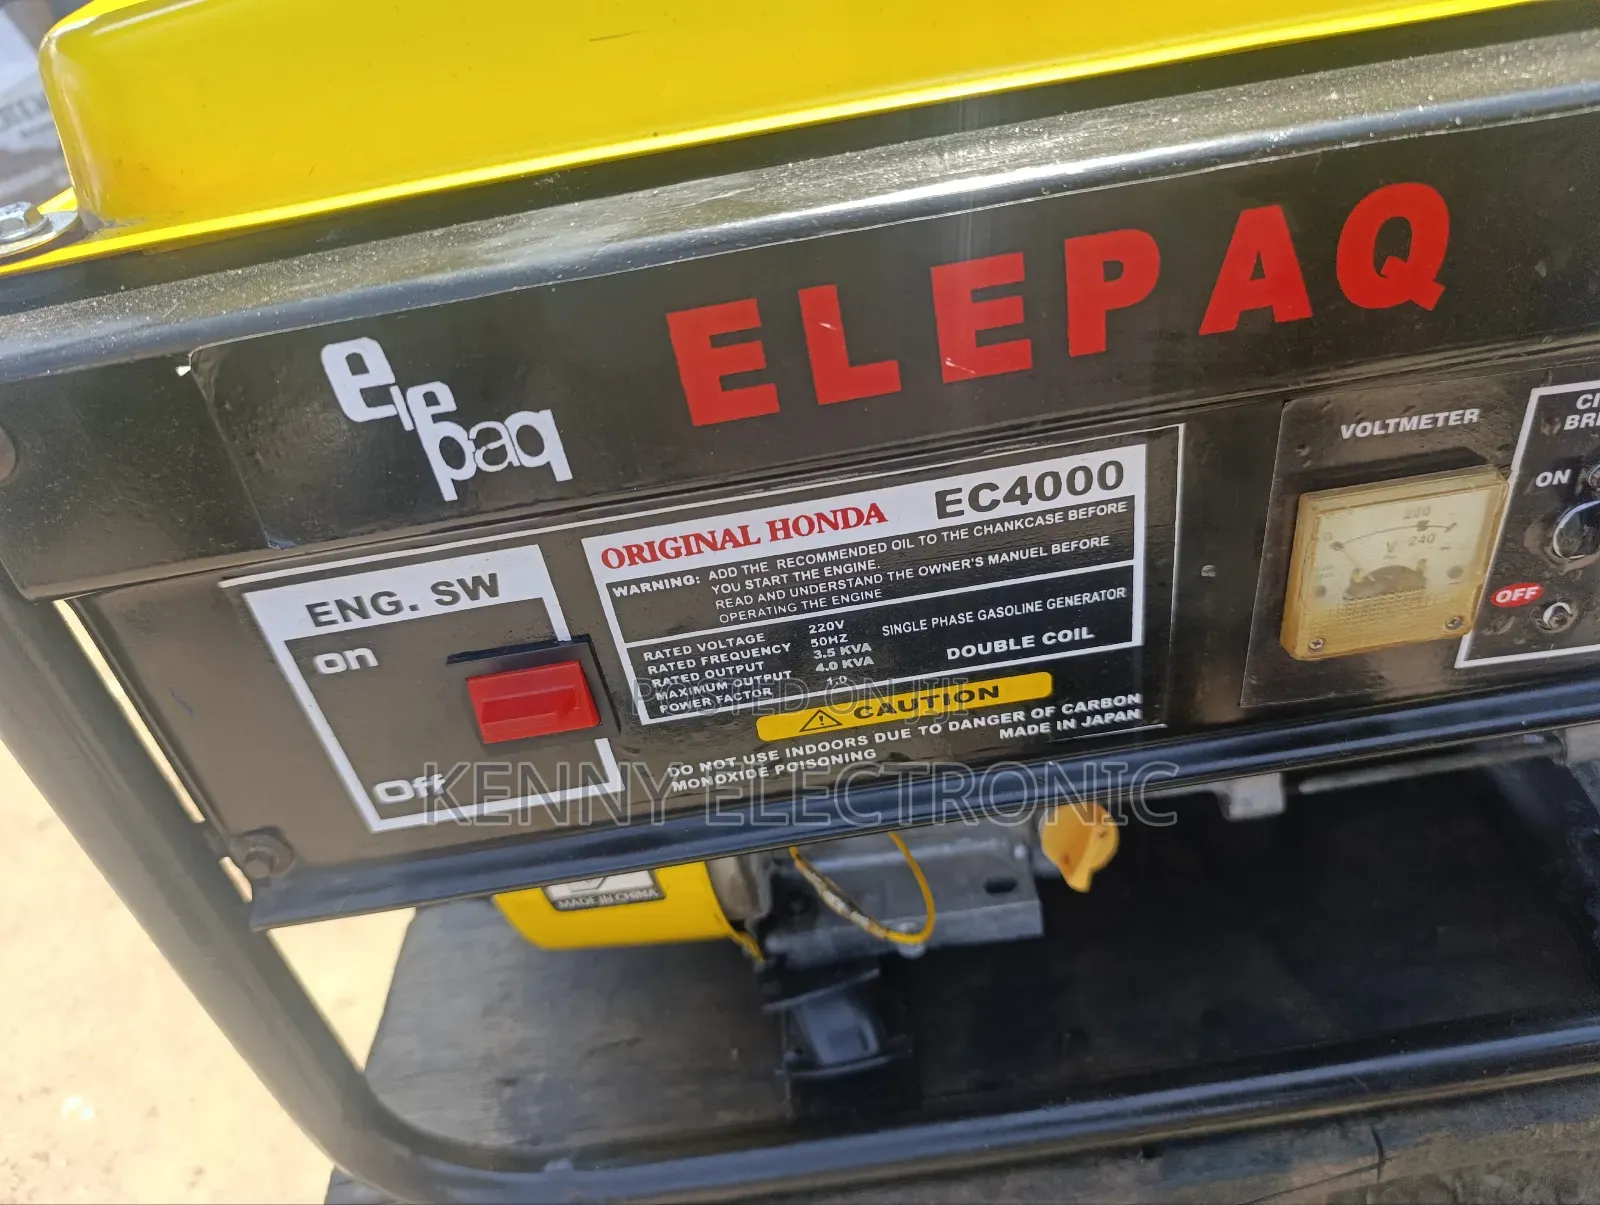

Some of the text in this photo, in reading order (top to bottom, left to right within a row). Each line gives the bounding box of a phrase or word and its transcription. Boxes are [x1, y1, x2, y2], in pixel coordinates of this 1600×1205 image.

[665, 181, 1450, 427] ELEPAQ
[1340, 408, 1480, 440] VOLTMETER
[935, 460, 1124, 519] EC4000
[1535, 469, 1572, 487] ON
[601, 503, 888, 569] ORIGINAL HONDA
[612, 501, 1128, 597] WARNING: ADD THE RECOMMENDED OIL TO THE CHANKCASE BEFORE
[711, 559, 881, 595] YOU START THE ENGINE.
[715, 536, 1110, 609] READ AND UNDERSTAND THE OWNER'S MANUEL BEFORE
[305, 572, 499, 627] ENG. SW
[719, 589, 882, 624] OPERATING THE ENGINE
[882, 587, 1127, 636] SINGLE PHASE GASOLINE GENERATOR
[1495, 584, 1539, 603] OFF
[313, 647, 379, 675] on
[643, 620, 845, 662] RATED VOLTAGE 220V
[647, 634, 848, 675] RATED FREQUENCY 50HZ
[946, 627, 1095, 660] DOUBLE COIL
[651, 642, 872, 688] RATED OUTPUT 3.5 KVA
[655, 656, 874, 701] MAXIMUM OUTPUT 4.0 KVA
[660, 675, 847, 714] POWER FACTOR 1.0
[853, 685, 1000, 719] CAUTION
[668, 692, 1143, 778] DO NOT USE INDOORS DUE TO DANGER OF CARBON
[999, 708, 1143, 739] MADE IN JAPAN
[372, 773, 446, 805] Off
[671, 749, 877, 792] MONOXIDE POISONING
[558, 893, 597, 909] MADE
[614, 887, 659, 902] CHINA
